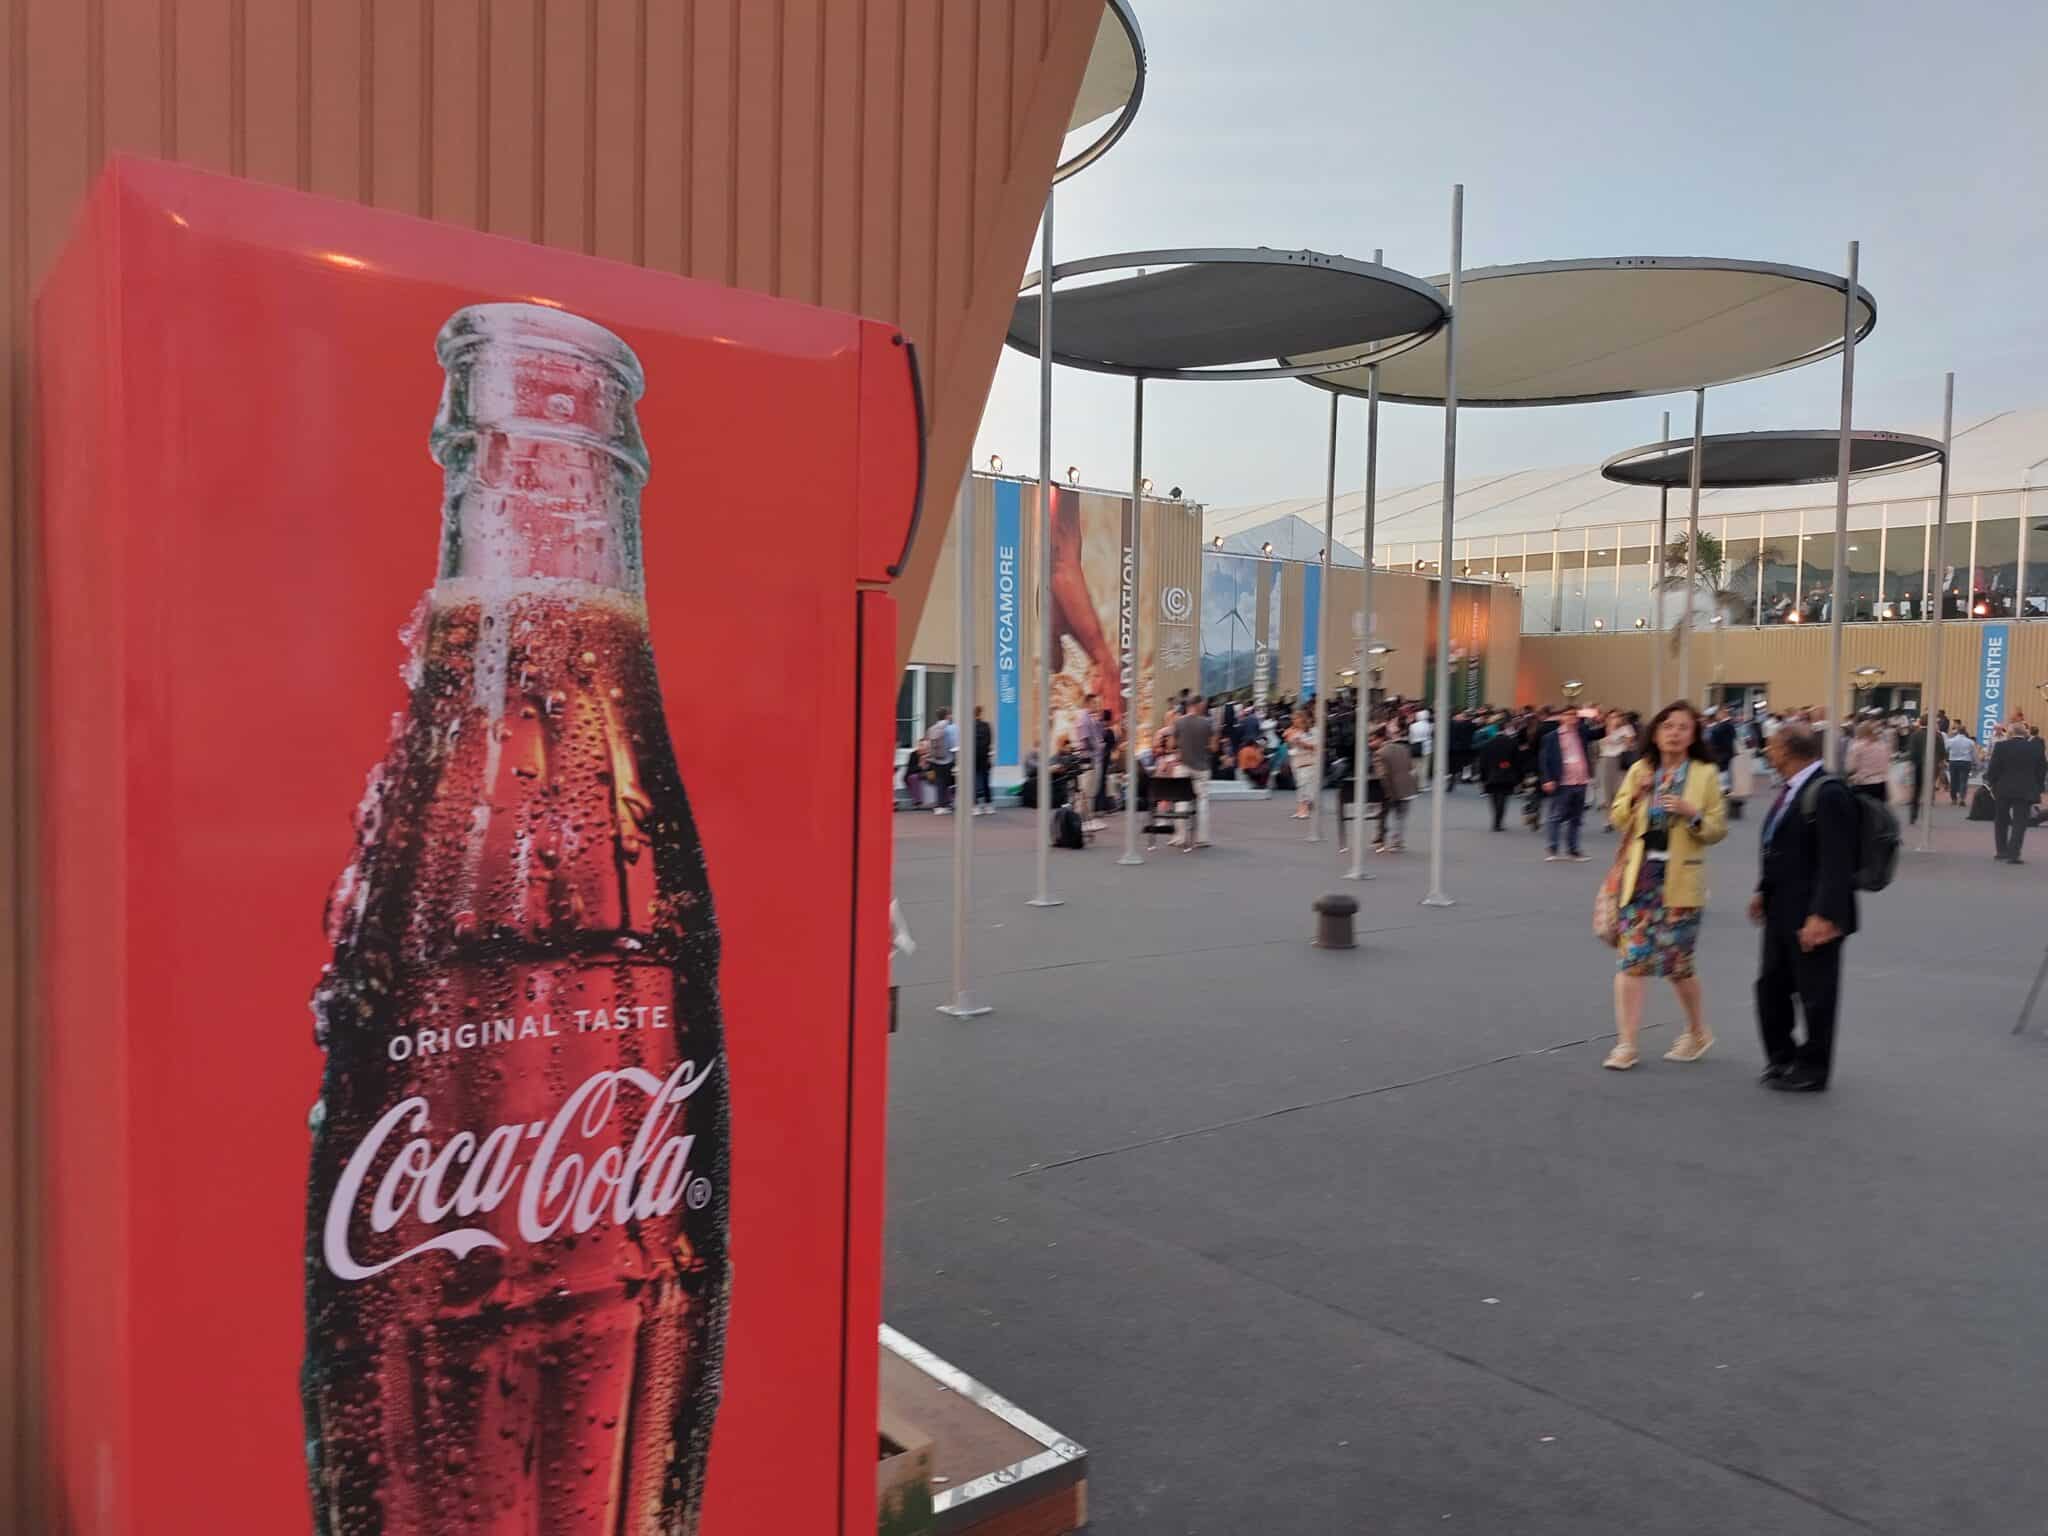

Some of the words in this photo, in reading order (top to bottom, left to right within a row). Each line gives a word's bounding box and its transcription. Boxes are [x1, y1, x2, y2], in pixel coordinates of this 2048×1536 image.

[999, 546, 1014, 670] SYCAMORE
[1985, 637, 2002, 699] CENTRE
[387, 1017, 561, 1062] ORIGINAL
[575, 1005, 671, 1034] TASTE
[323, 1056, 718, 1281] Coca-Cola
